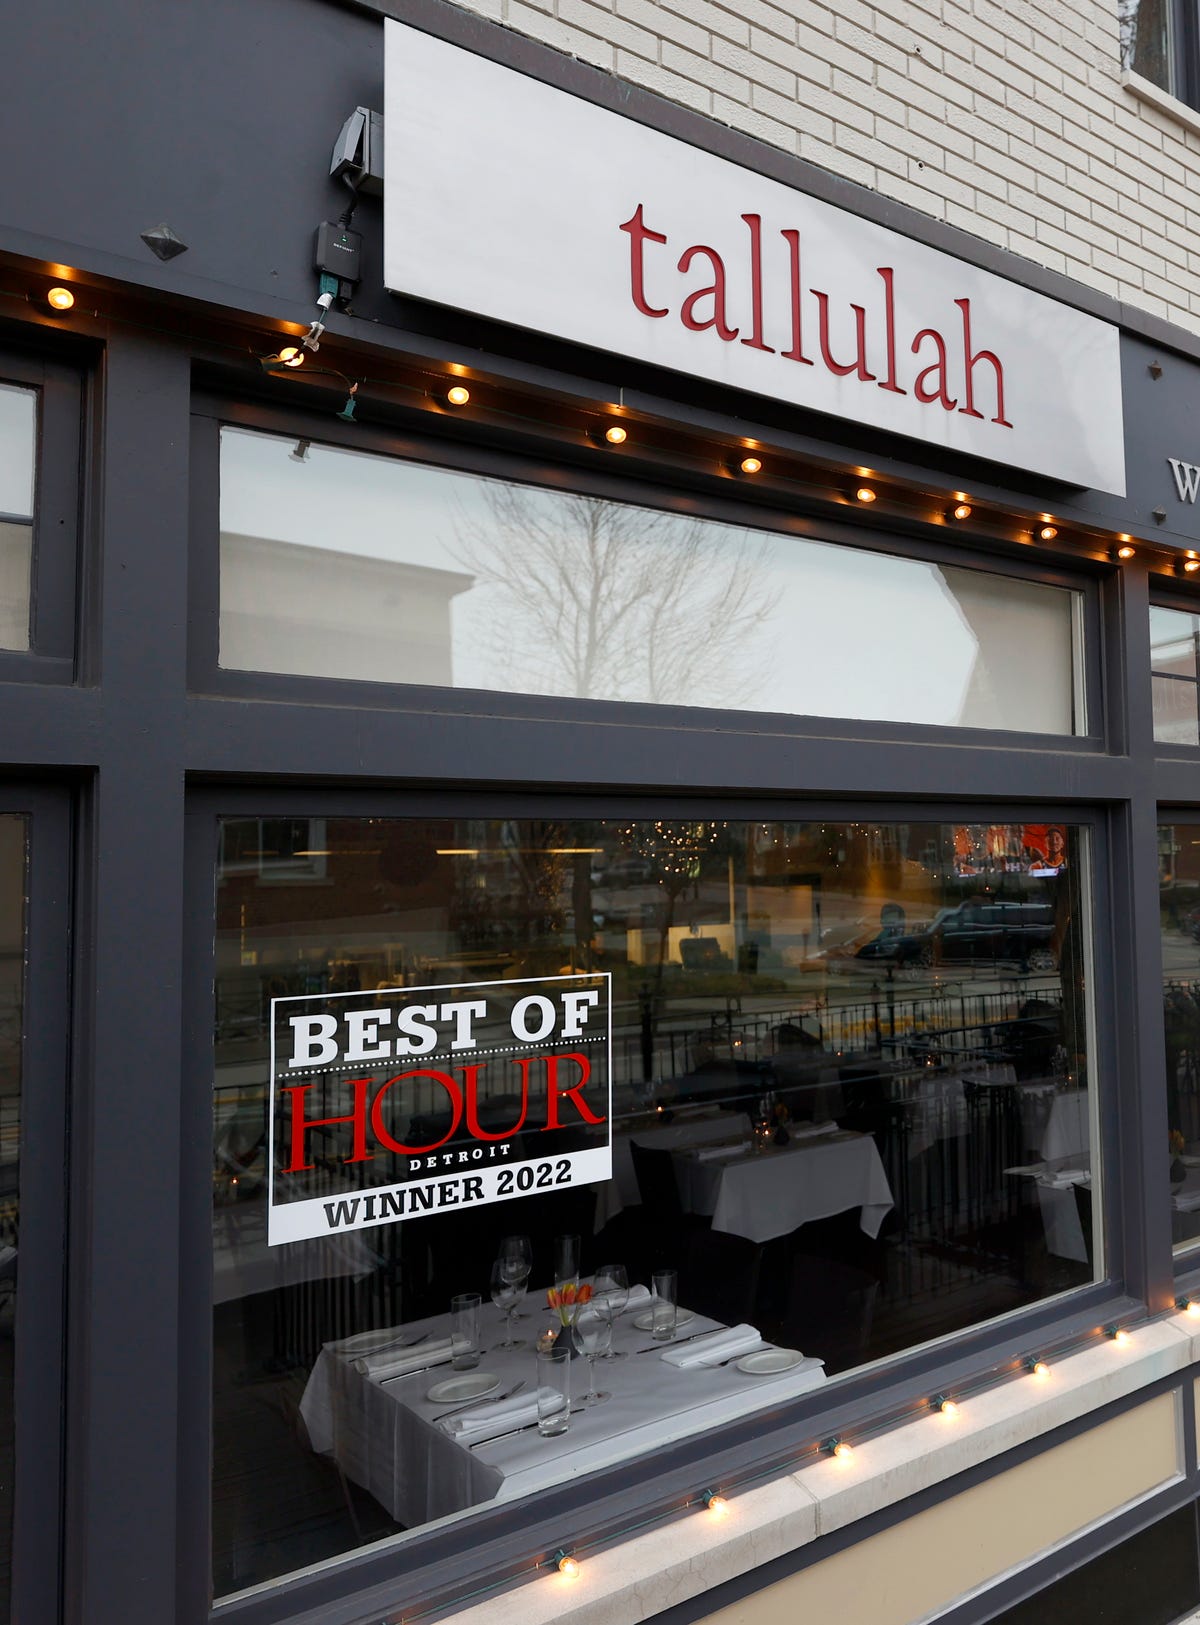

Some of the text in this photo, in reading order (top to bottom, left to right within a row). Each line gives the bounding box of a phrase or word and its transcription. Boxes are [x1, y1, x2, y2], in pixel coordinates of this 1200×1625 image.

[619, 203, 1014, 429] tallulah
[288, 990, 599, 1068] BEST OF
[280, 1052, 607, 1174] HOUR
[323, 1159, 573, 1229] WINNER 2022
[409, 1144, 510, 1171] DETROIT
